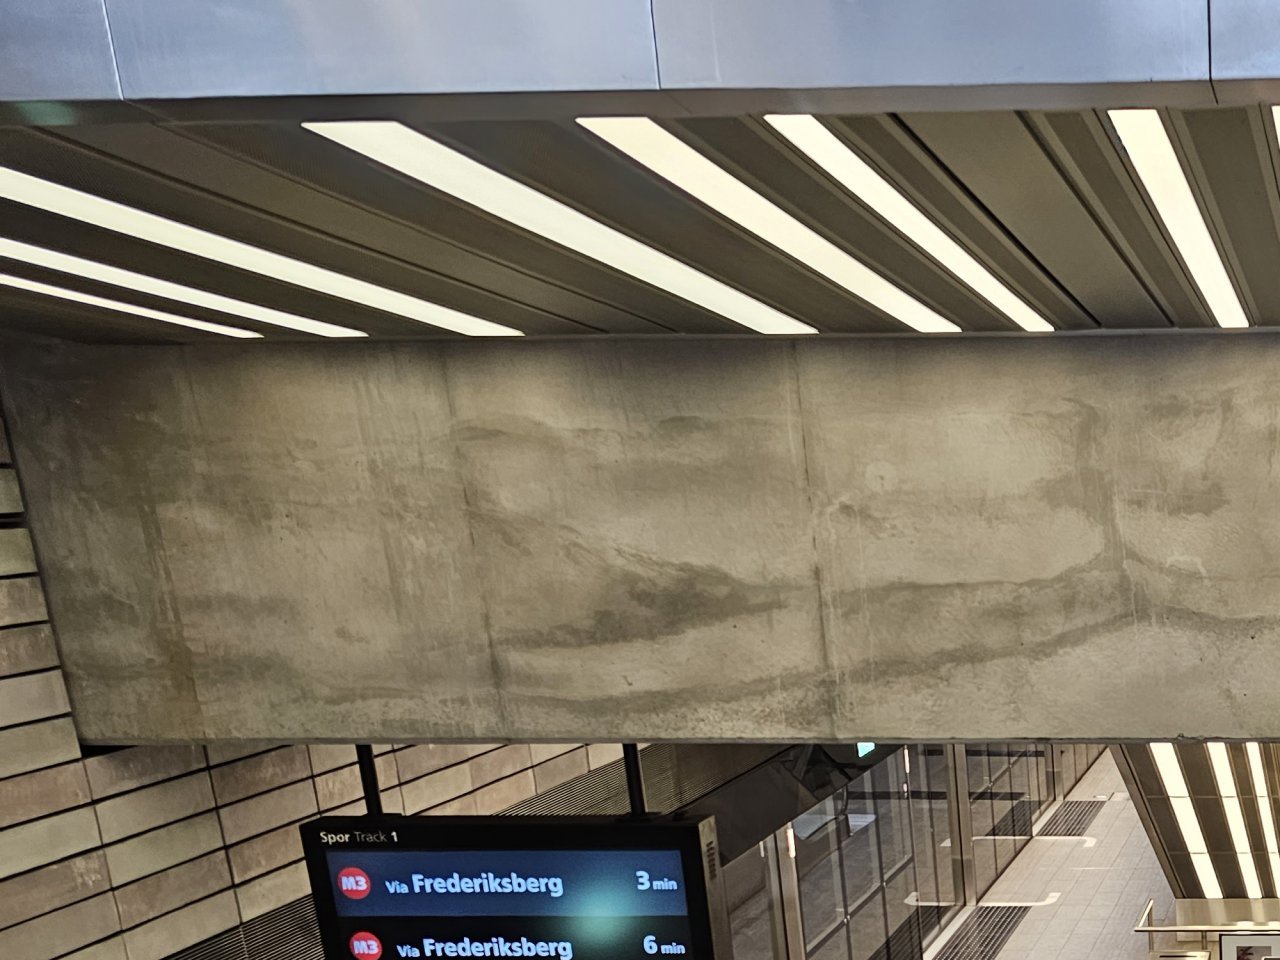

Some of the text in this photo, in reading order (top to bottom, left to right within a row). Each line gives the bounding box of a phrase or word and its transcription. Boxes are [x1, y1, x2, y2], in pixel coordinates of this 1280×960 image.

[319, 831, 399, 845] Spor Track 1
[341, 875, 369, 891] M3
[385, 872, 565, 897] Via Frederiksberg
[635, 870, 678, 891] 3 min
[353, 939, 379, 955] M3
[396, 937, 575, 960] Via Frederiksberg
[643, 934, 686, 955] 6 min
